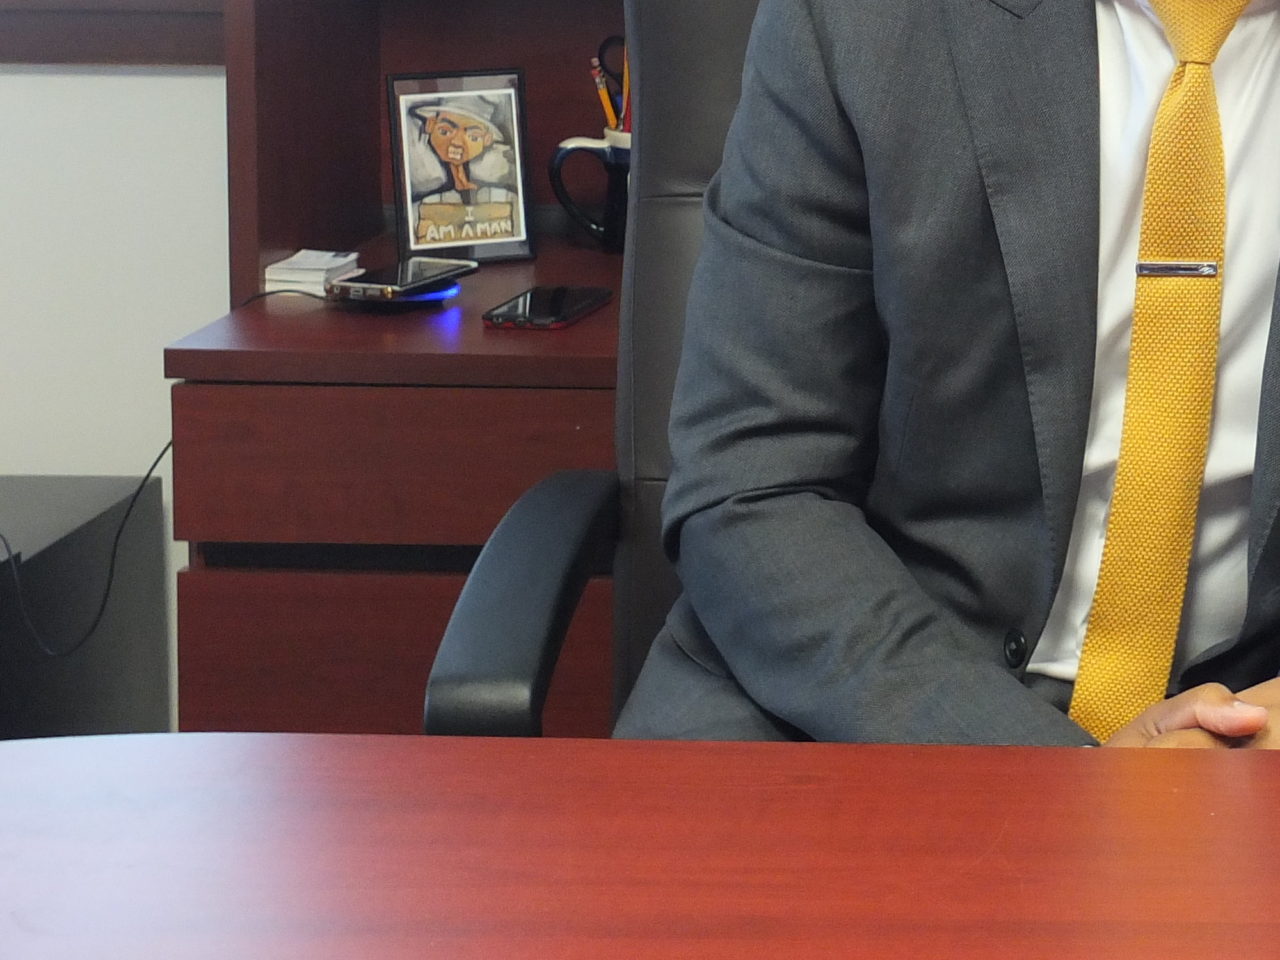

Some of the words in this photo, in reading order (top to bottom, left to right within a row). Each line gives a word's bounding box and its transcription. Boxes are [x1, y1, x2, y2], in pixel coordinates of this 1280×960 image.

[464, 206, 475, 221] I
[426, 224, 455, 241] AM
[461, 224, 474, 239] A
[476, 219, 512, 238] MAN
